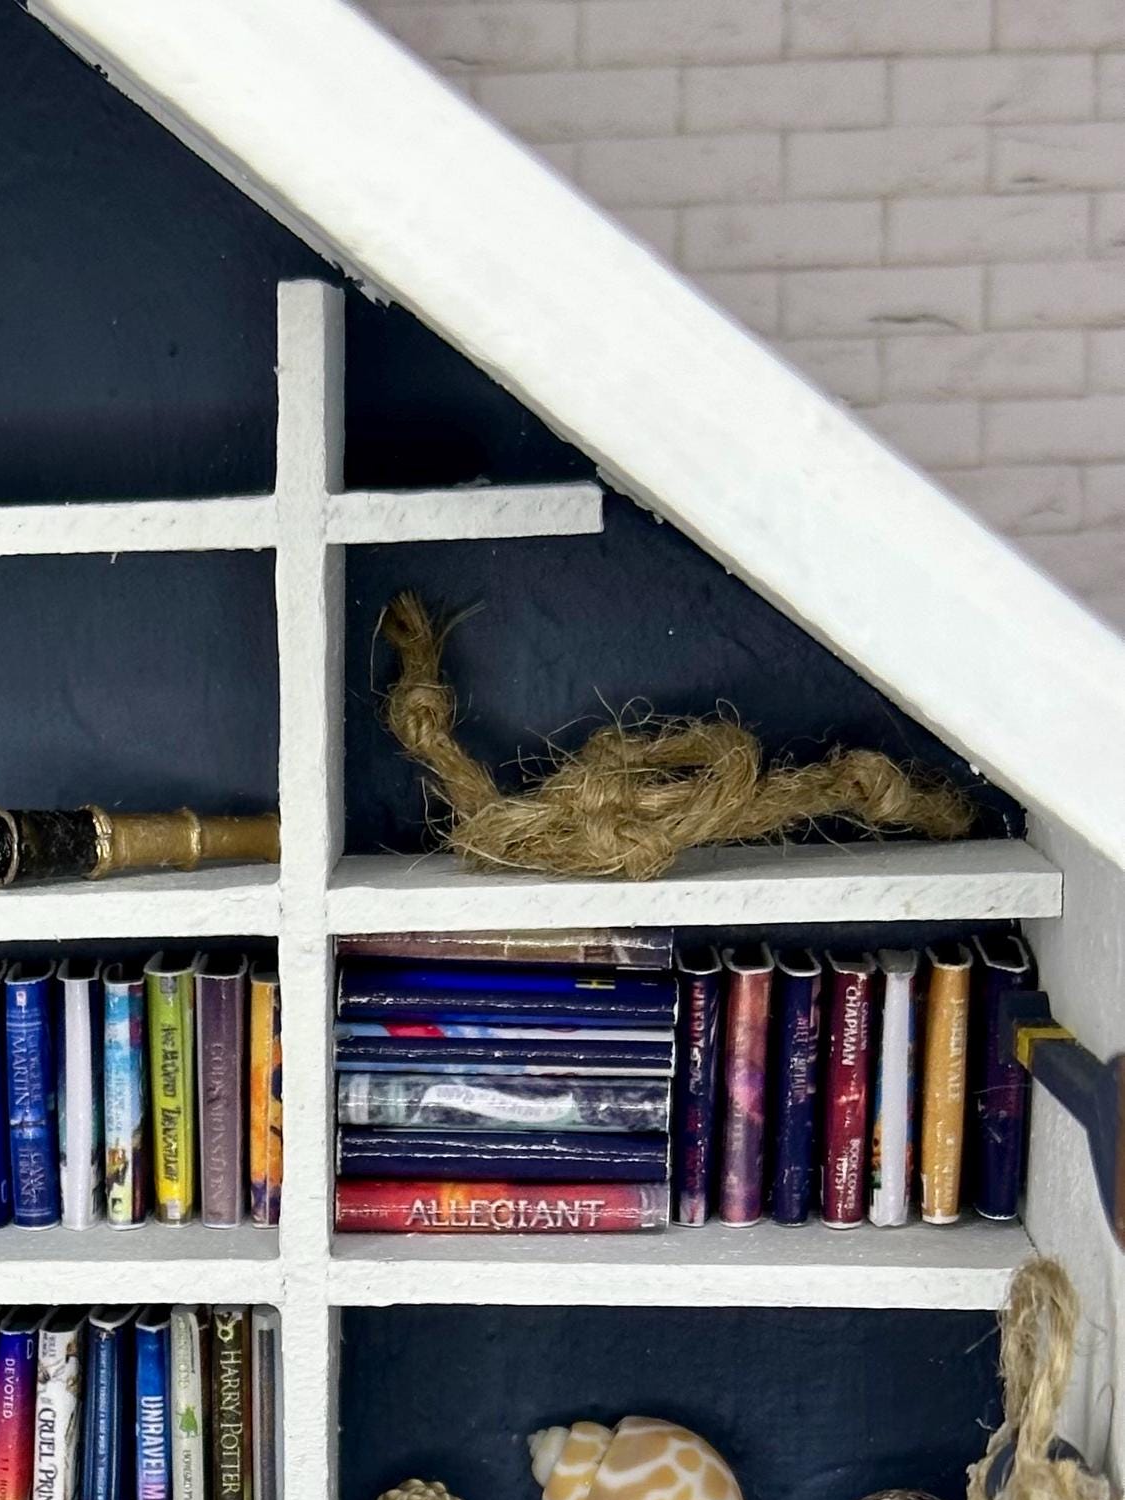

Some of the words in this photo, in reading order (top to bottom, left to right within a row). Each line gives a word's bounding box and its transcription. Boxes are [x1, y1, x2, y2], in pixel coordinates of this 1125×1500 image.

[840, 985, 858, 1067] CHAPMAN
[12, 1033, 29, 1112] MARTIN
[849, 1138, 861, 1172] BOOK
[405, 1199, 606, 1228] ALLEGIANT
[2, 1357, 16, 1420] DEVOTED
[220, 1350, 243, 1421] HARRY
[38, 1406, 57, 1469] CRUEL
[140, 1394, 165, 1483] UNRAVEL
[219, 1422, 243, 1495] POTTER
